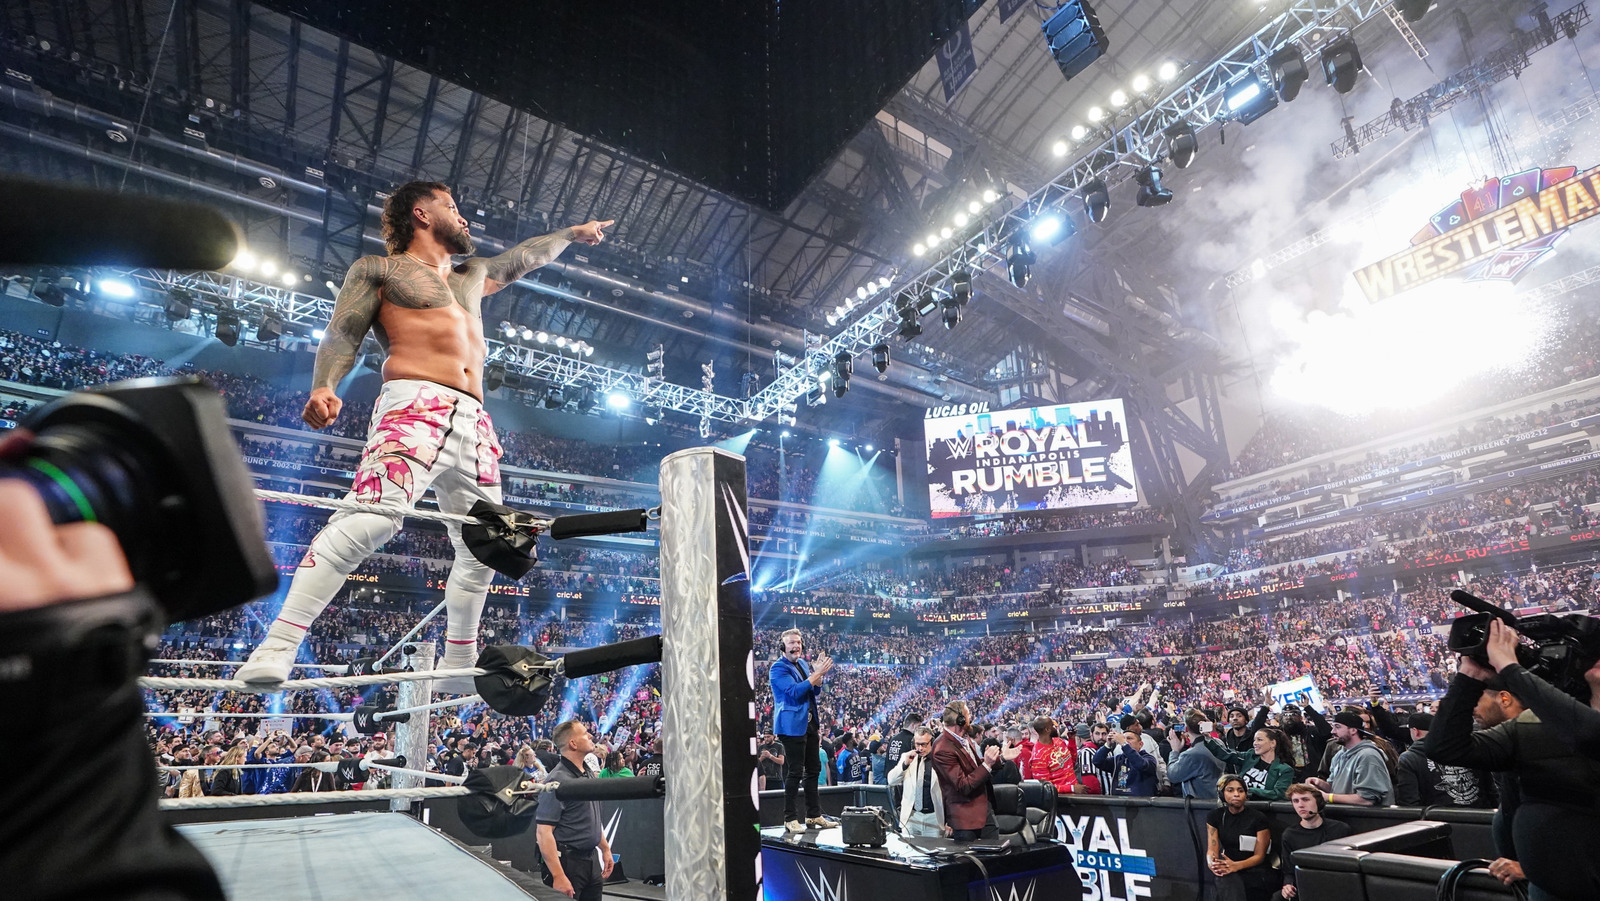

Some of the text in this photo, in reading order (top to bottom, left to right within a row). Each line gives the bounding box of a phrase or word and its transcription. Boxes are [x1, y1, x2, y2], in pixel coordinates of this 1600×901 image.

[1473, 191, 1496, 213] 41
[925, 401, 990, 419] LUCAS OIL
[975, 424, 1103, 459] ROYAL
[1441, 448, 1471, 461] DWIGHT
[1473, 438, 1511, 453] FREENEY
[272, 461, 302, 471] 2002-08
[976, 450, 1080, 468] INDIANAPOLIS
[952, 457, 1107, 495] RUMBLE
[1324, 480, 1347, 491] ROBERT
[1347, 473, 1372, 486] MATHIS
[507, 496, 527, 504] JAMES
[1249, 500, 1268, 510] GLENN
[487, 584, 530, 597] UMBLE
[1226, 578, 1305, 600] ROYAL RUMBLE
[790, 605, 855, 617] ROYAL RUMBLE
[923, 612, 987, 623] ROYAL RUMBLE
[1069, 602, 1142, 615] ROYAL RUMBLE
